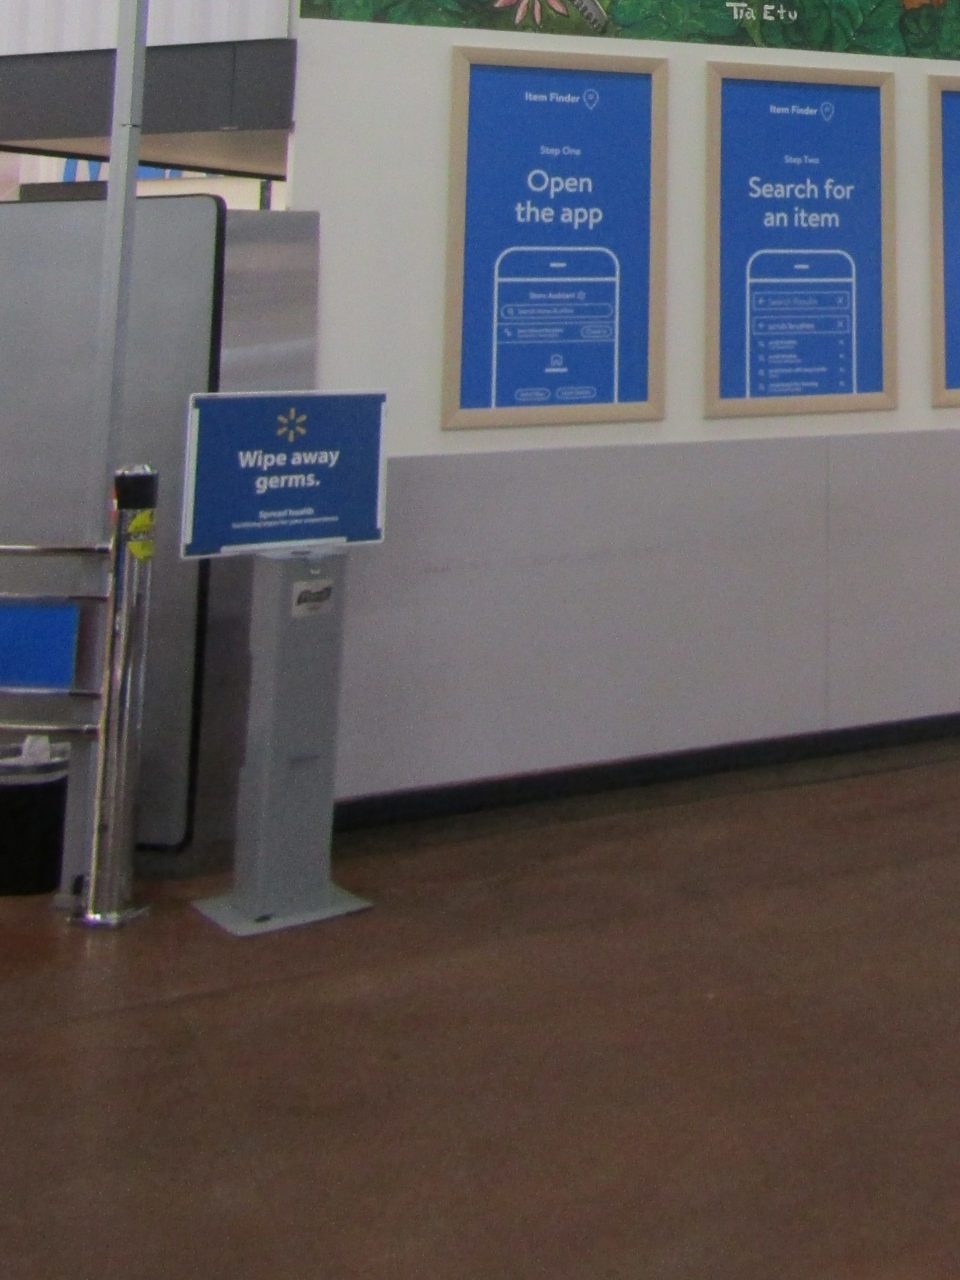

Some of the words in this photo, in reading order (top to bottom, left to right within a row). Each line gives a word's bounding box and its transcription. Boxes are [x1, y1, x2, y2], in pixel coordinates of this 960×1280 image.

[725, 1, 756, 21] Tia
[762, 3, 798, 21] Etu
[524, 91, 548, 102] Item
[549, 91, 580, 104] Finder
[769, 104, 790, 114] Item
[791, 105, 818, 116] Finder
[540, 145, 560, 157] Step
[562, 145, 581, 156] One
[784, 154, 802, 166] Step
[803, 154, 820, 165] Two
[526, 168, 593, 200] Open
[747, 176, 820, 200] Search
[823, 178, 856, 201] for
[515, 201, 555, 224] the
[559, 204, 604, 231] app
[763, 209, 789, 229] an
[793, 206, 840, 229] item
[238, 450, 287, 470] Wipe
[291, 449, 340, 468] away
[255, 473, 320, 494] germs.
